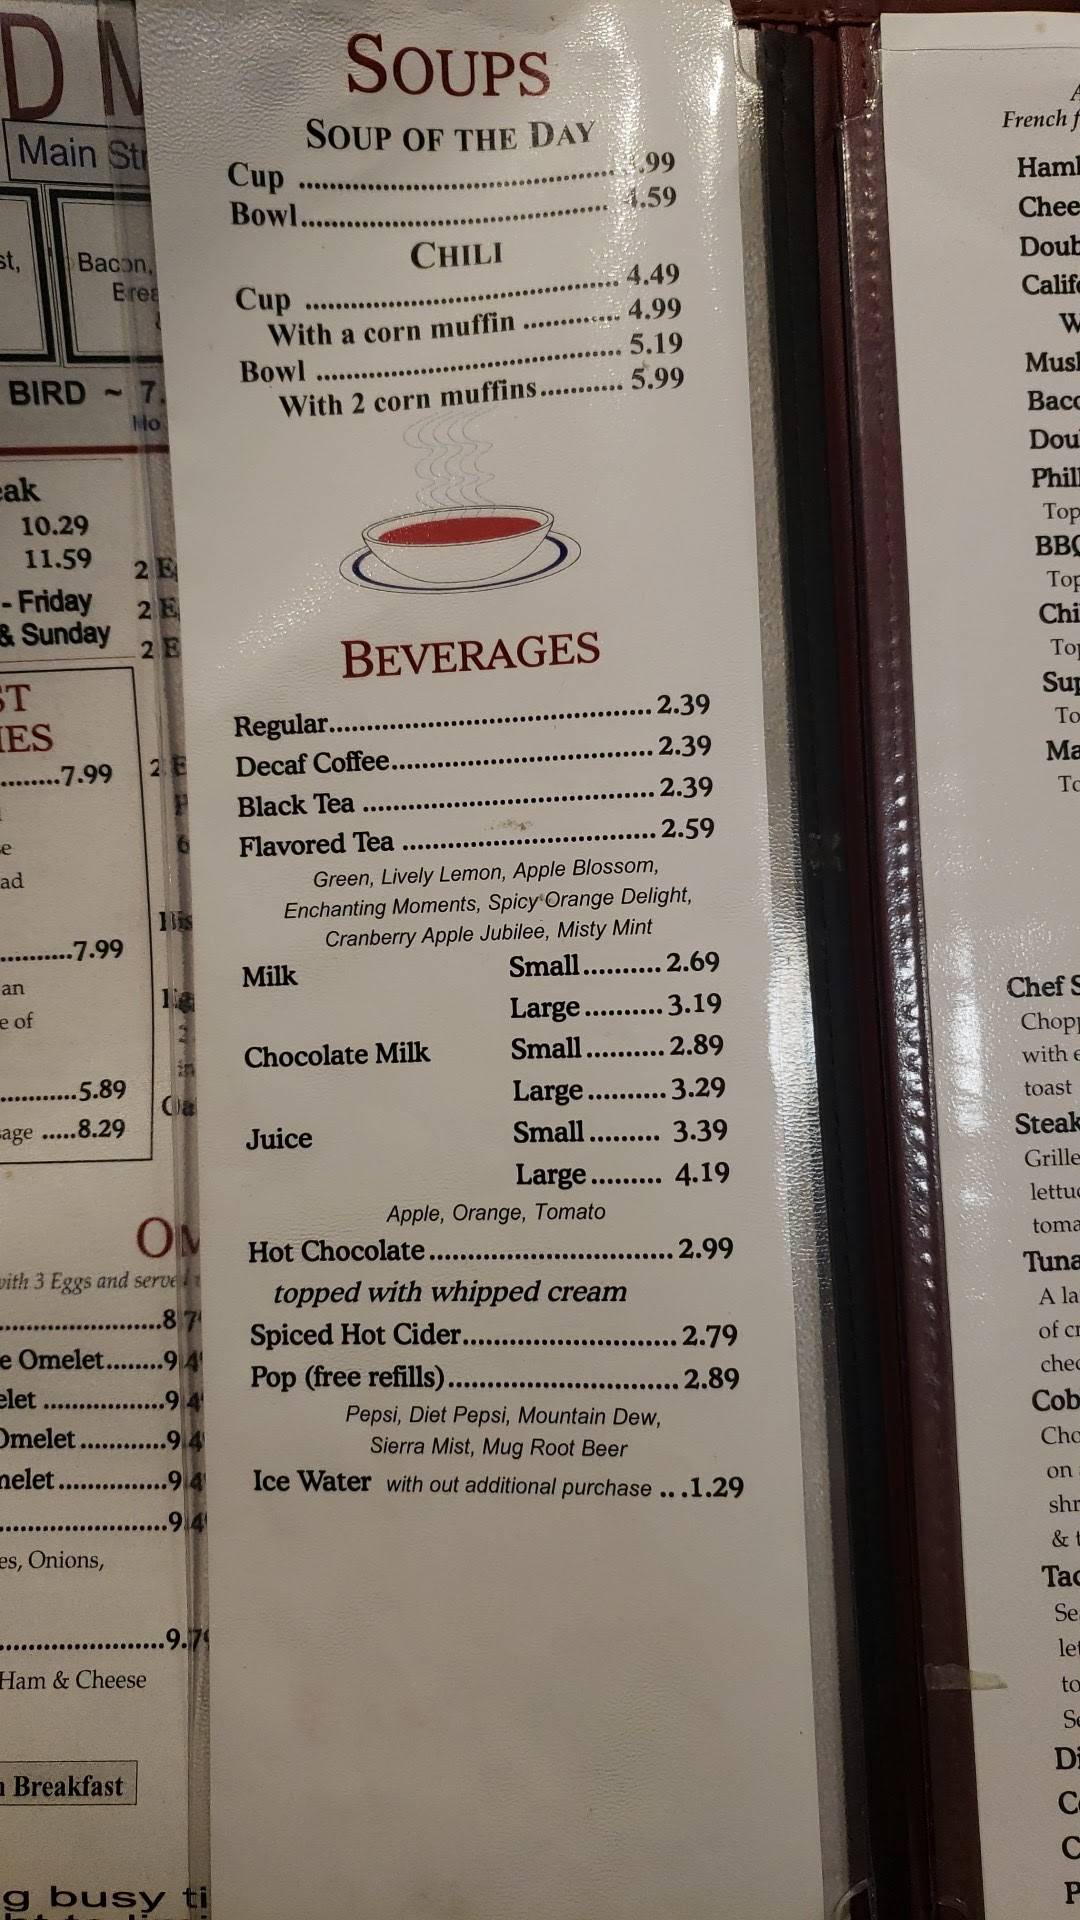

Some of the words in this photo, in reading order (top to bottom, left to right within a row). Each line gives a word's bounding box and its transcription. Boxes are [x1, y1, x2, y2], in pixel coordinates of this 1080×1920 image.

[1002, 111, 1067, 129] French
[18, 134, 97, 169] Main
[228, 162, 284, 194] Cup
[230, 201, 297, 227] Bowl
[236, 287, 290, 317] Cup
[627, 263, 679, 285] 4.49
[267, 323, 332, 346] With
[342, 328, 355, 345] a
[364, 325, 421, 343] corn
[431, 312, 515, 339] muffin
[628, 297, 681, 320] 4.99
[240, 360, 305, 383] Bowl
[630, 332, 682, 355] 5.19
[9, 380, 86, 406] BIRD
[279, 394, 343, 417] With
[352, 392, 365, 414] 2
[374, 393, 430, 413] corn
[441, 379, 536, 407] muffins
[632, 369, 684, 390] 5.99
[22, 515, 90, 536] 10.29
[25, 549, 92, 570] 11.59
[19, 589, 93, 617] Friday
[22, 621, 111, 648] Sunday
[234, 713, 328, 741] Regular
[657, 694, 710, 716] 2.39
[236, 753, 308, 777] Decaf
[313, 750, 389, 773] Coffee
[659, 735, 711, 757] 2.39
[60, 764, 113, 788] 7.99
[237, 794, 308, 817] Black
[313, 793, 355, 814] Tea
[660, 776, 713, 798] 2.39
[239, 832, 346, 857] Flavored
[352, 831, 395, 852] Tea
[661, 818, 714, 839] 2.59
[314, 871, 373, 888] Green,
[382, 867, 434, 887] Lively
[440, 866, 505, 882] Lemon,
[513, 861, 565, 882] Apple
[573, 859, 658, 876] Blossom,
[284, 900, 386, 919] Enchanting
[392, 896, 480, 914] Moments,
[489, 893, 539, 914] Spicy
[545, 891, 614, 910] Orange
[621, 886, 691, 907] Delight,
[326, 929, 417, 948] Cranberry
[421, 926, 473, 947] Apple
[480, 923, 549, 941] Jubilee,
[558, 921, 607, 941] Misty
[613, 918, 653, 935] Mint
[73, 938, 124, 962] 7.99
[242, 965, 298, 987] Milk
[510, 953, 580, 977] Small
[667, 951, 719, 972] 2.69
[1007, 974, 1063, 999] Chef
[14, 1011, 33, 1030] of
[510, 997, 580, 1022] Large
[668, 993, 721, 1016] 3.19
[245, 1044, 368, 1068] Chocolate
[375, 1041, 431, 1064] Milk
[512, 1036, 582, 1060] Small
[670, 1034, 723, 1056] 2.89
[1022, 1042, 1067, 1063] with
[79, 1079, 127, 1102] 5.89
[513, 1080, 583, 1106] Large
[672, 1077, 725, 1100] 3.29
[1024, 1079, 1072, 1097] toast
[78, 1118, 126, 1141] 8.29
[246, 1128, 312, 1150] Juice
[514, 1120, 584, 1143] Small
[673, 1119, 727, 1142] 3.39
[516, 1163, 586, 1190] Large
[675, 1162, 729, 1186] 4.19
[386, 1205, 444, 1226] Apple,
[453, 1204, 525, 1225] Orange,
[536, 1203, 605, 1220] Tomato
[248, 1241, 294, 1263] Hot
[301, 1239, 425, 1262] Chocolate
[679, 1237, 733, 1260] 2.99
[34, 1274, 45, 1290] 3
[51, 1273, 92, 1295] Eggs
[97, 1271, 129, 1289] and
[274, 1281, 362, 1308] topped
[368, 1280, 422, 1303] with
[432, 1280, 541, 1307] whipped
[548, 1286, 627, 1302] cream
[1038, 1287, 1055, 1306] A
[251, 1323, 334, 1350] Spiced
[341, 1323, 386, 1345] Hot
[393, 1322, 461, 1345] Cider
[683, 1324, 737, 1348] 2.79
[1039, 1321, 1059, 1340] of
[19, 1348, 104, 1371] Omelet
[251, 1366, 296, 1392] Pop
[305, 1365, 361, 1391] (free
[368, 1365, 444, 1392] refills)
[684, 1367, 739, 1390] 2.89
[346, 1405, 401, 1427] Pepsi,
[410, 1406, 447, 1423] Diet
[453, 1406, 509, 1427] Pepsi,
[518, 1406, 605, 1425] Mountain
[613, 1408, 660, 1428] Dew,
[371, 1436, 424, 1455] Sierra
[432, 1437, 474, 1458] Mist,
[483, 1437, 523, 1460] Mug
[530, 1438, 575, 1456] Root
[582, 1439, 628, 1457] Beer
[253, 1469, 290, 1492] Ice
[296, 1470, 372, 1492] Water
[387, 1475, 423, 1492] with
[430, 1476, 459, 1493] out
[465, 1476, 556, 1495] additional
[562, 1478, 652, 1499] purchase
[1047, 1464, 1074, 1480] on
[1052, 1529, 1069, 1549] &
[28, 1550, 105, 1572] Onions,
[53, 1671, 70, 1690] &
[76, 1669, 147, 1689] Cheese
[14, 1775, 124, 1798] Breakfast
[51, 1885, 167, 1913] busy
